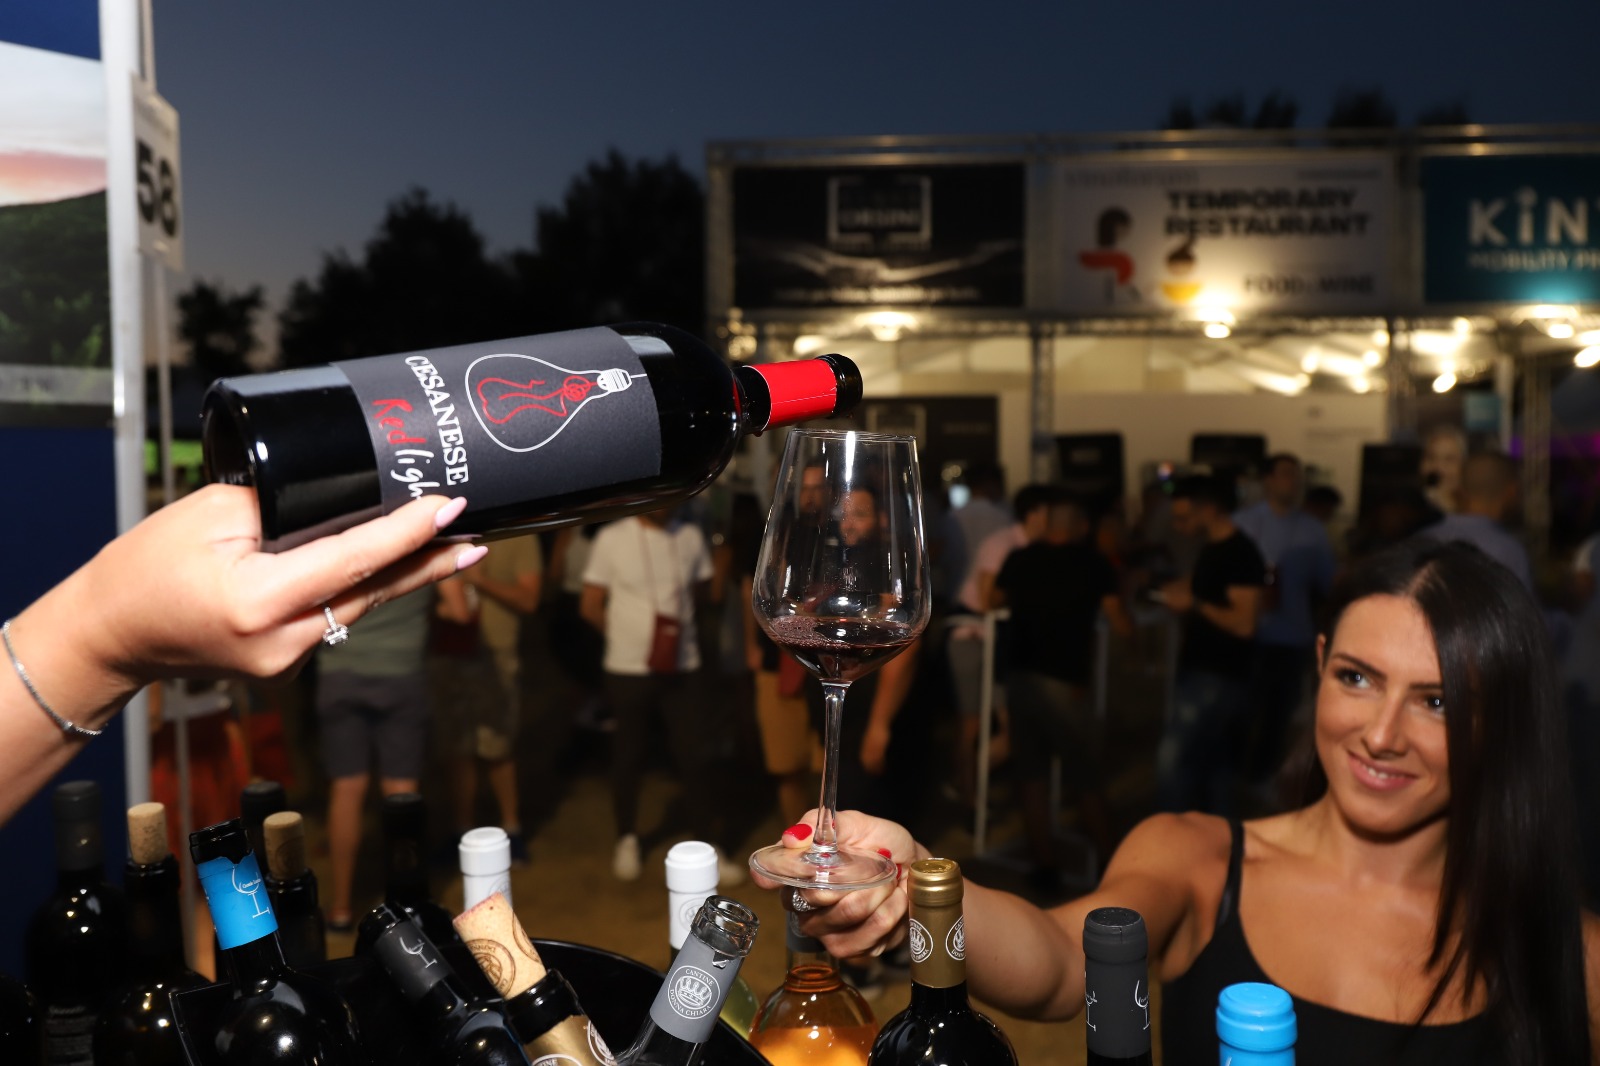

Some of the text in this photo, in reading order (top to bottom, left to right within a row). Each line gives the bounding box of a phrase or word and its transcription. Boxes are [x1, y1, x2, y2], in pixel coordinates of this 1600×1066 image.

[136, 138, 178, 238] 58
[1167, 189, 1357, 211] TEMPORARY
[1164, 214, 1369, 236] RESTAURANT
[1468, 252, 1568, 271] MOBILITY
[405, 356, 469, 486] CESANESE
[390, 449, 441, 500] ligh
[685, 968, 714, 986] CANTINE
[670, 989, 711, 1017] DONNA CHIARA
